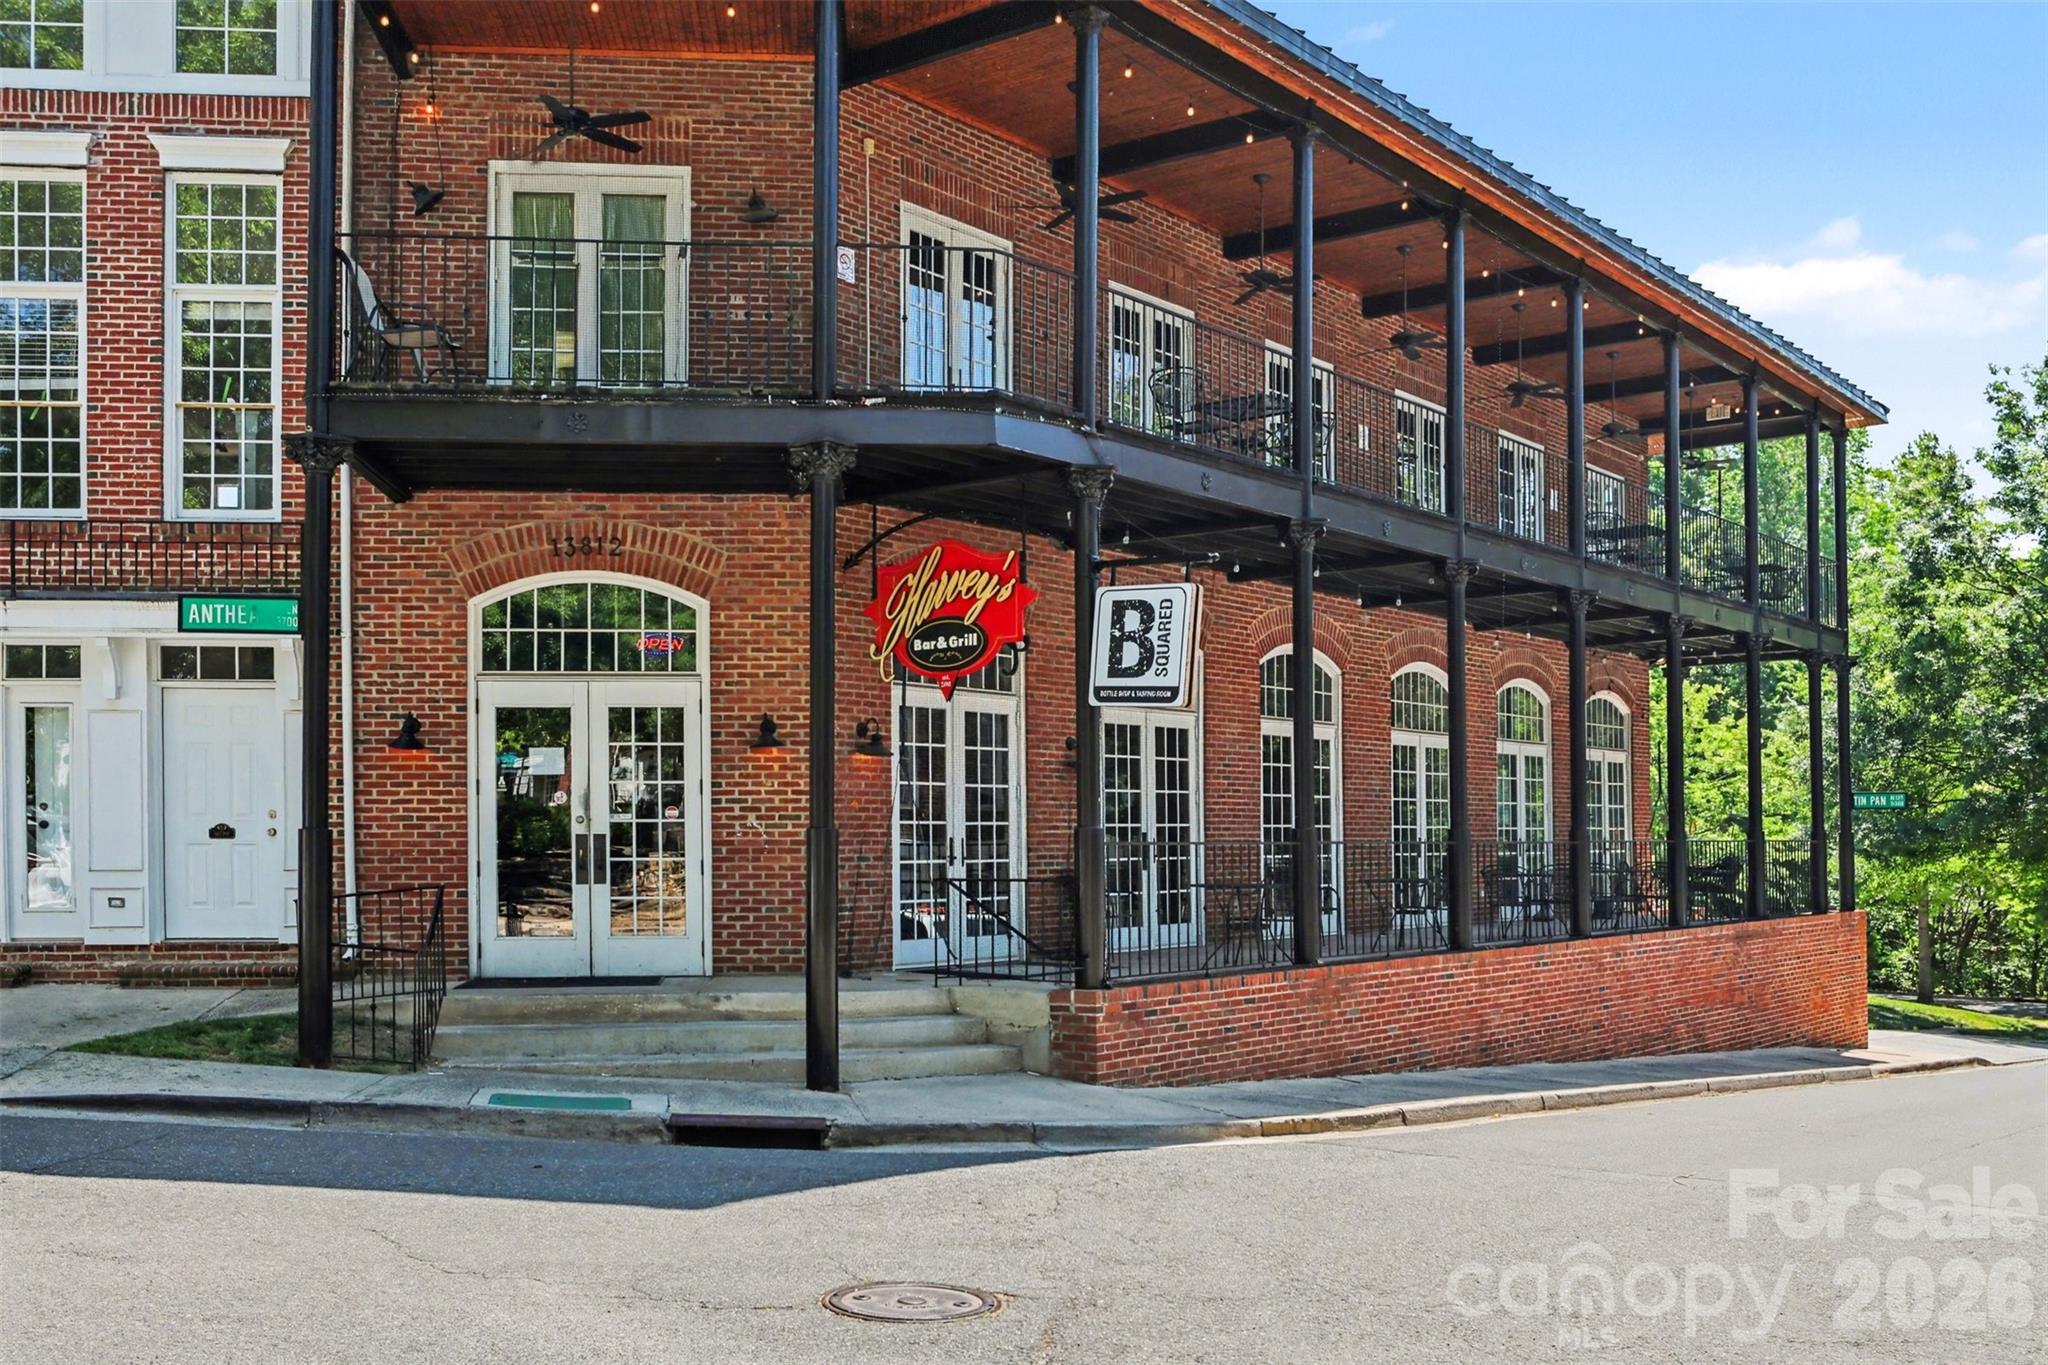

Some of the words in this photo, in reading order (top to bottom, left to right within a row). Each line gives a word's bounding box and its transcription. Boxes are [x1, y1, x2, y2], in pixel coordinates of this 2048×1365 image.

[551, 536, 622, 557] 13812
[870, 546, 1016, 682] Harvey's
[1107, 599, 1155, 678] B
[1154, 599, 1174, 677] SQUARED
[636, 638, 685, 651] OPEN
[1853, 795, 1867, 806] TIN
[1870, 795, 1887, 806] PAN
